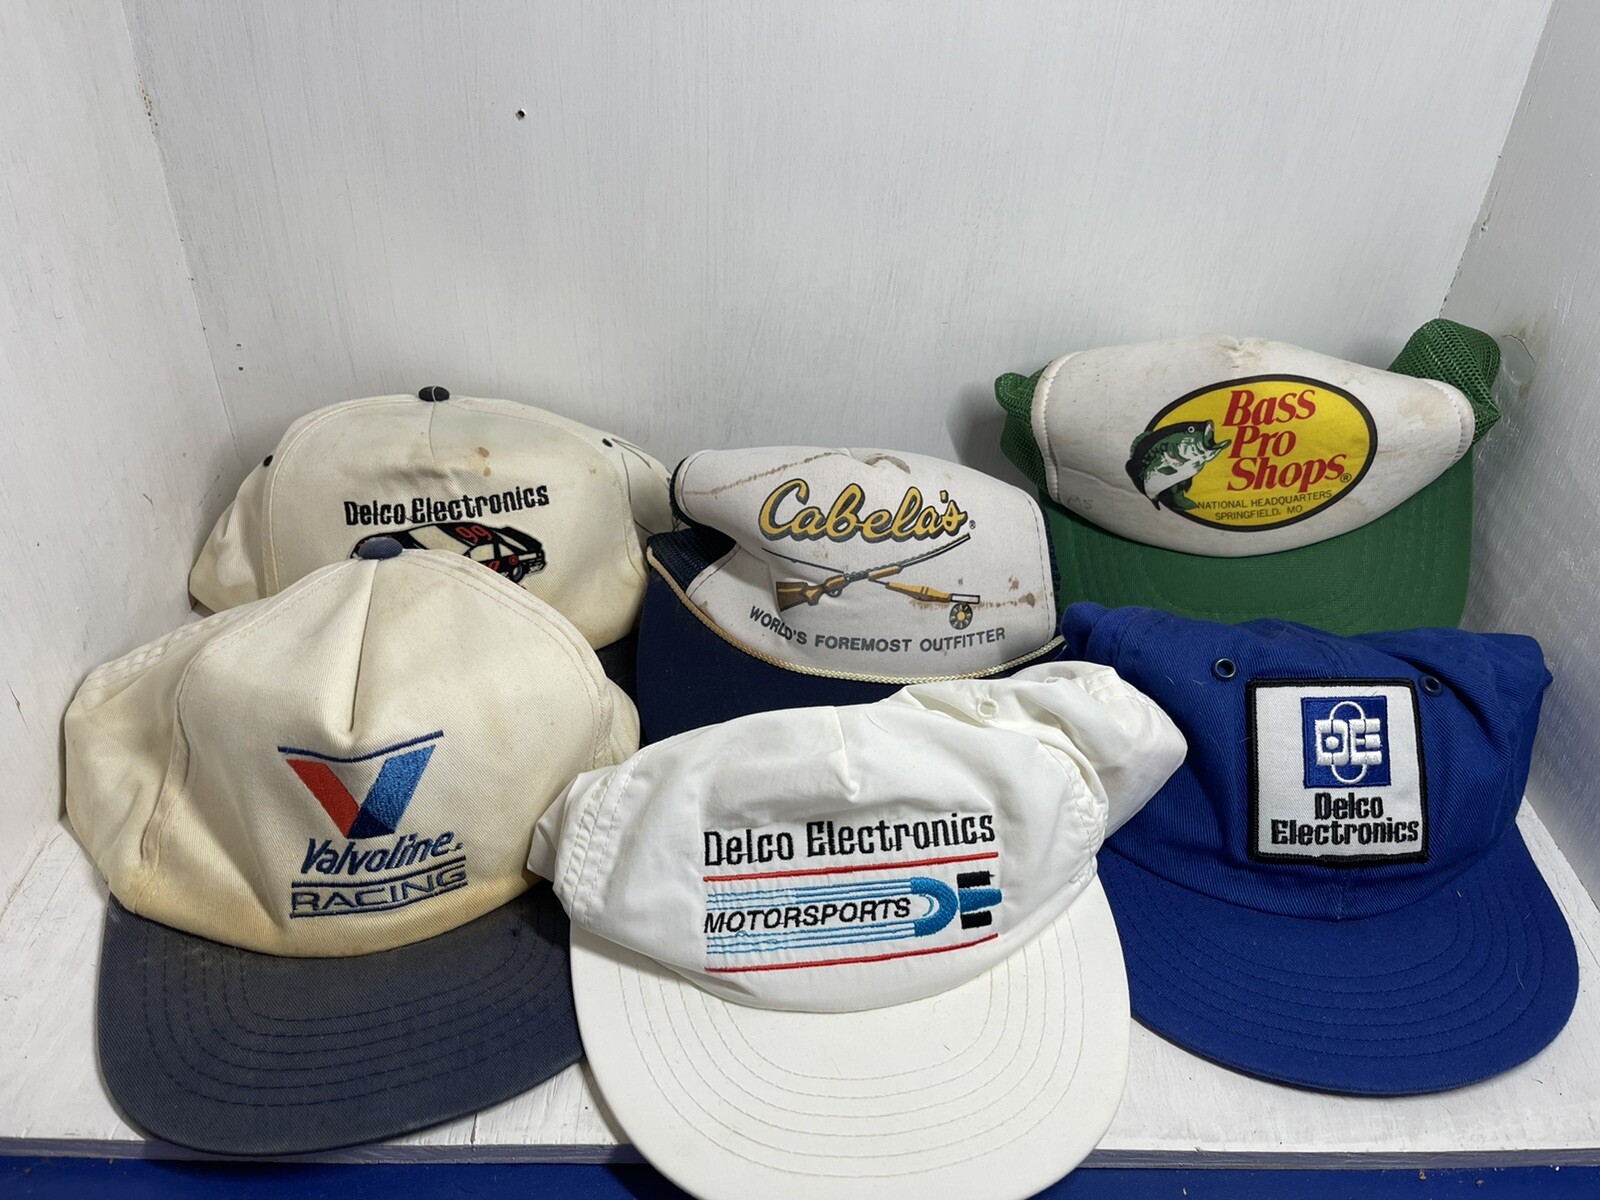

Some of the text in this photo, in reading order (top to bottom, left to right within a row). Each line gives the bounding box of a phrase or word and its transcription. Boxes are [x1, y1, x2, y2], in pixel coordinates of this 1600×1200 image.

[1222, 389, 1316, 427] Bass
[1228, 425, 1297, 459] Pro
[344, 485, 549, 525] Delco Electronics
[1197, 490, 1332, 510] NATIONAL HEADQUARTERS
[1286, 505, 1303, 514] MO
[456, 525, 492, 543] 99
[750, 606, 1006, 652] WORLD'S FOREMOST OUTFITTER
[1314, 792, 1383, 820] Delco
[704, 812, 996, 866] Delco Electronics
[1271, 817, 1419, 845] Electronics
[292, 865, 467, 910] RACING
[704, 898, 911, 933] MOTORSPORTS
